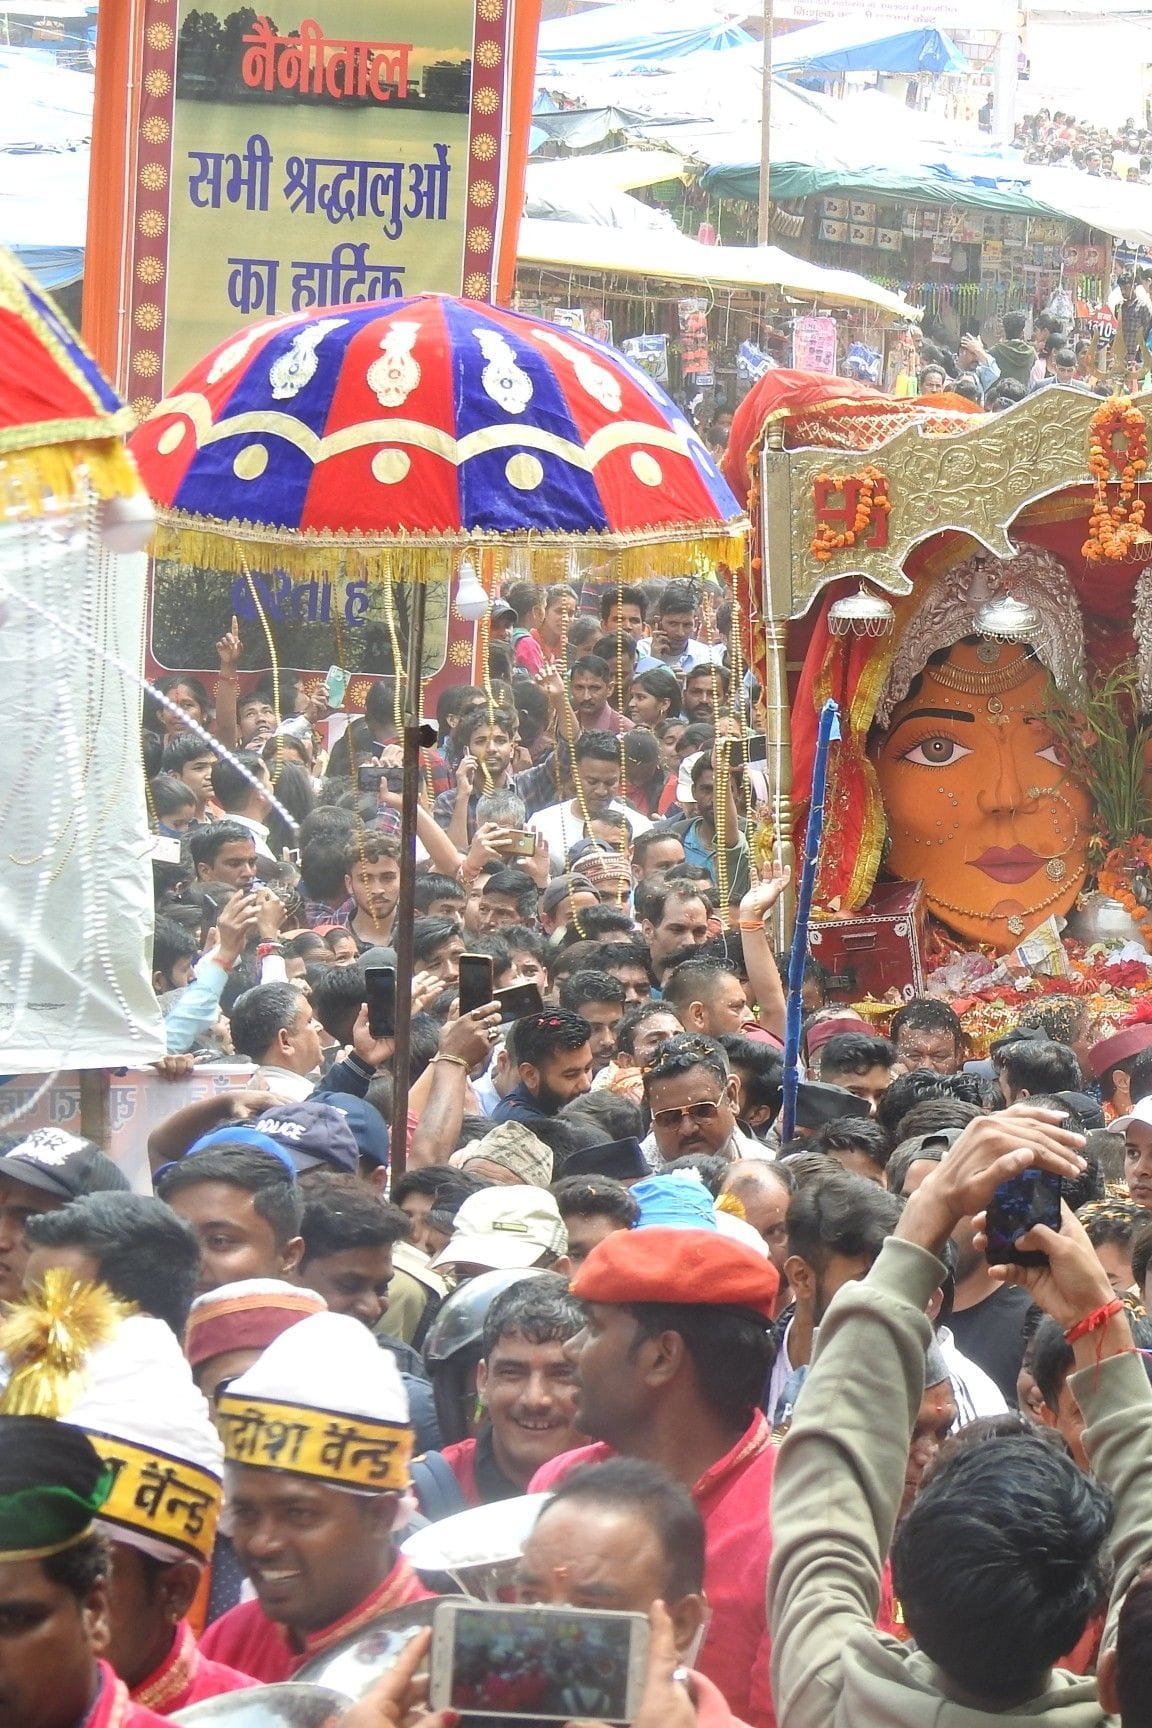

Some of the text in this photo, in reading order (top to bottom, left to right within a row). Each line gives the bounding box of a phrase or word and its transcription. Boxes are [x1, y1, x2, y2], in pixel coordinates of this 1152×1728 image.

[242, 15, 413, 100] नैनीताल
[188, 133, 451, 240] सभी श्रद्धालुओं
[227, 242, 405, 315] का हार्दिक
